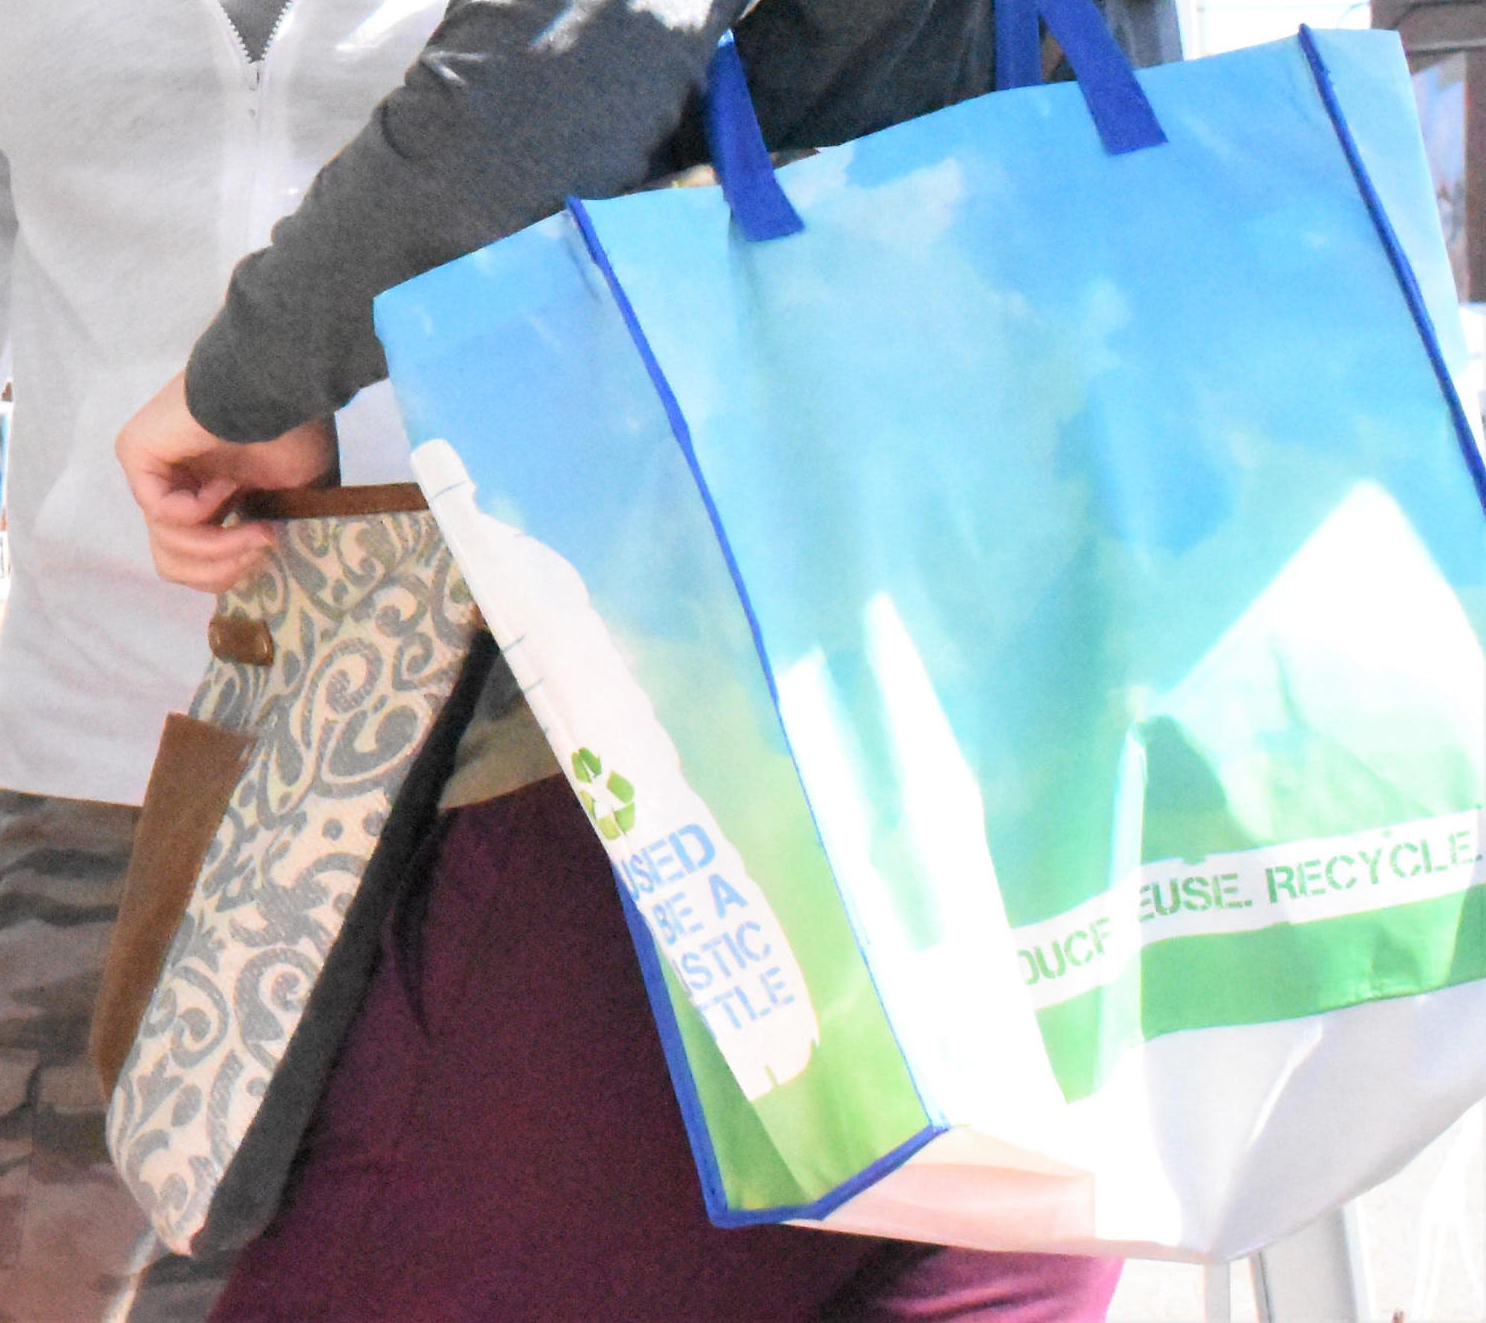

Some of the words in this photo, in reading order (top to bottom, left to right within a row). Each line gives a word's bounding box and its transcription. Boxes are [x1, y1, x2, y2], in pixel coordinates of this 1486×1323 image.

[708, 873, 749, 919] A
[1265, 830, 1484, 904] RECYCLE.
[673, 921, 772, 996] STIC
